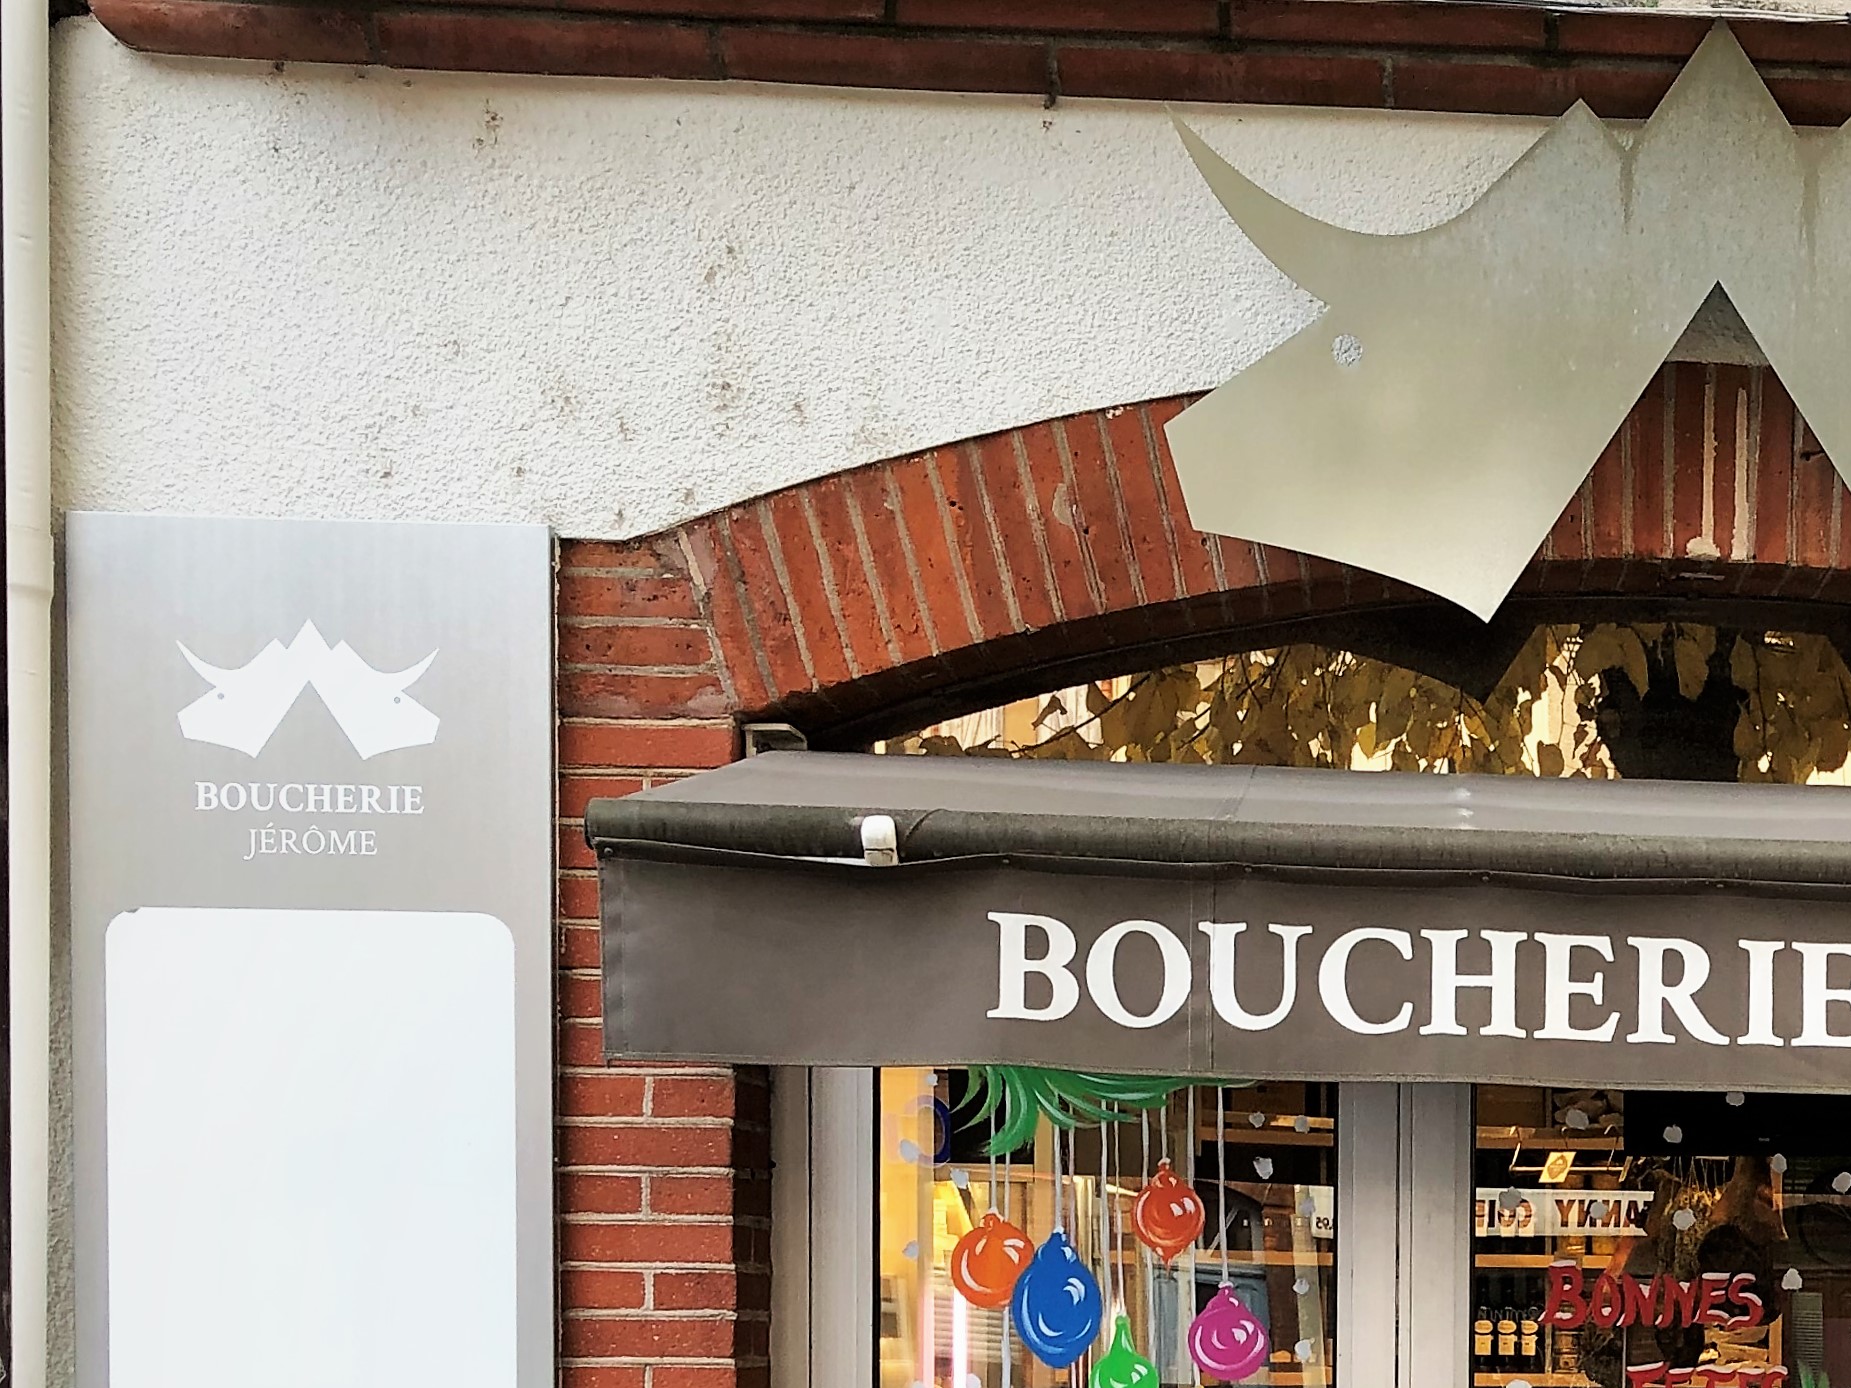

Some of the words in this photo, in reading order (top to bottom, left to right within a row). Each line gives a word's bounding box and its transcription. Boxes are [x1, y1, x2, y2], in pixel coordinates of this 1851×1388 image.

[194, 781, 425, 815] BOUCHERIE
[243, 822, 379, 861] JÉRÔME
[1539, 1259, 1764, 1329] BONNES
